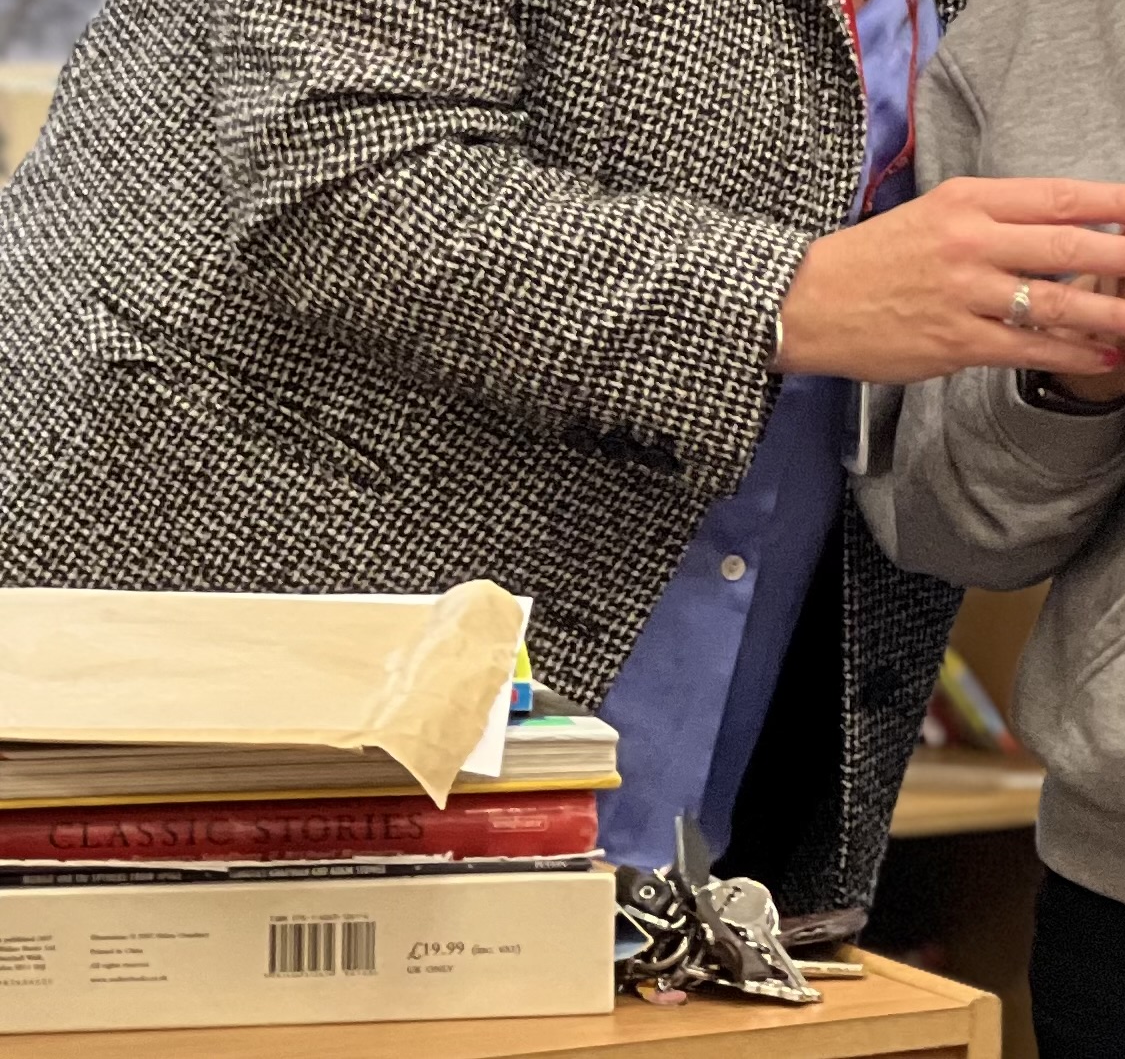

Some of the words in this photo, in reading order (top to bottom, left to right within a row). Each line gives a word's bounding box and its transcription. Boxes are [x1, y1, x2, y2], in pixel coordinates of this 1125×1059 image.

[49, 817, 232, 850] CLASSIC
[255, 811, 425, 842] STORIES
[406, 941, 465, 961] £19.99
